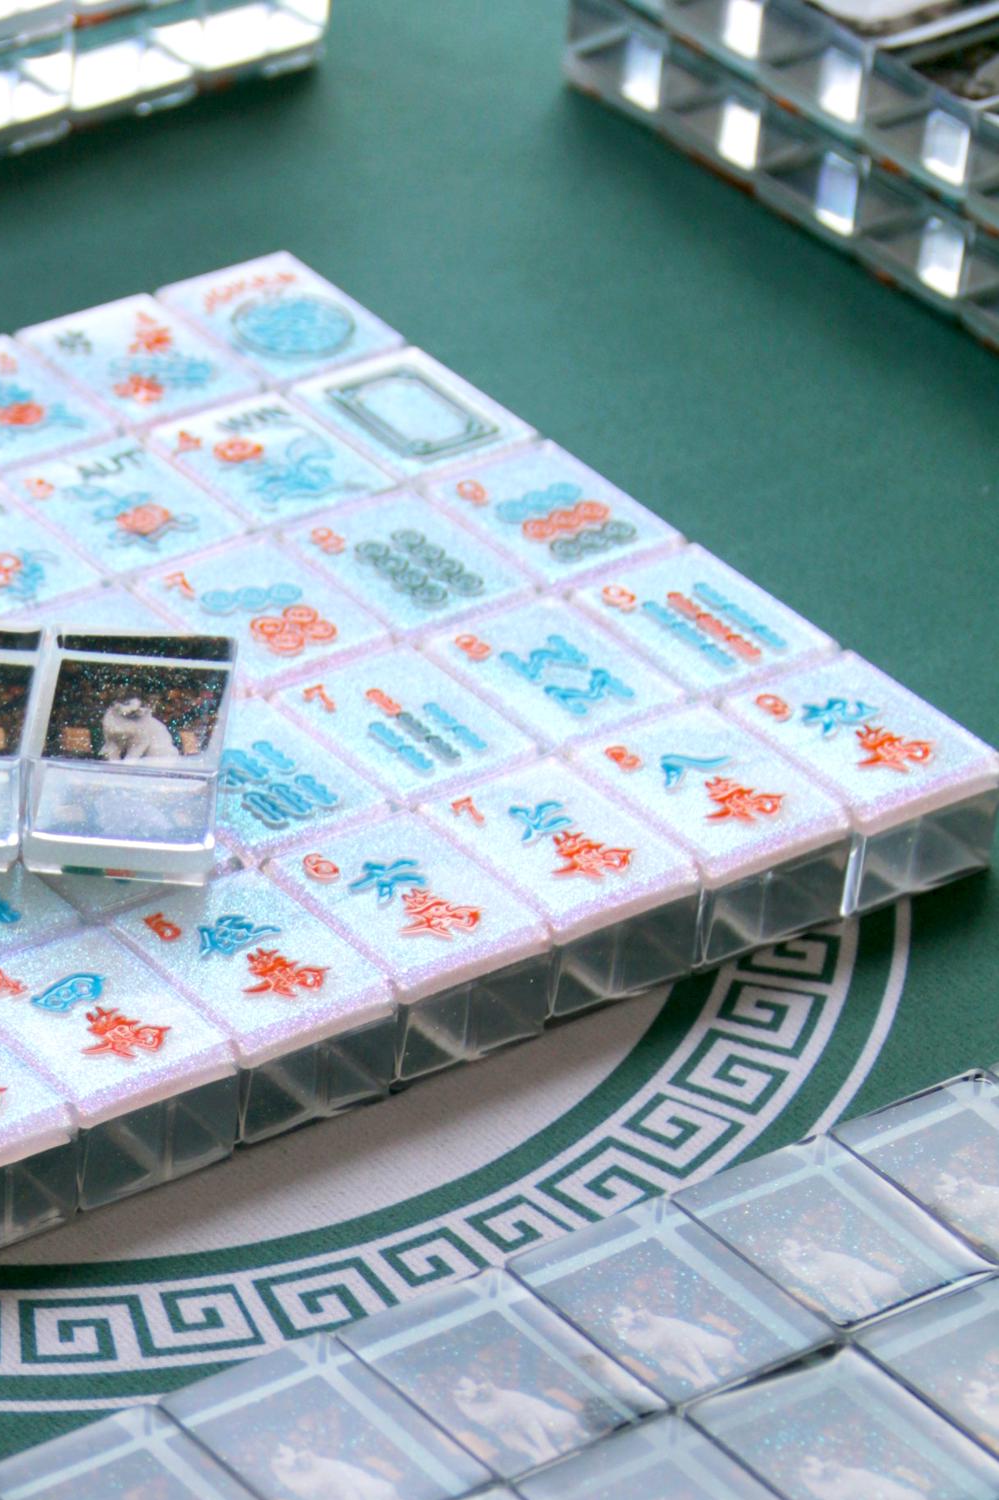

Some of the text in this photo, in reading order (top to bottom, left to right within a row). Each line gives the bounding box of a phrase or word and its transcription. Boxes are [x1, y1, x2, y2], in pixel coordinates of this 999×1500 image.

[77, 449, 143, 483] AUT
[456, 480, 488, 505] 9
[312, 528, 344, 552] 8
[164, 572, 194, 596] 7
[602, 585, 636, 610] 9
[455, 635, 491, 659] 8
[303, 683, 336, 711] 7
[755, 694, 789, 719] 9
[605, 746, 639, 769] 8
[451, 796, 484, 824] 7
[303, 853, 339, 882] 6
[144, 913, 181, 941] 5
